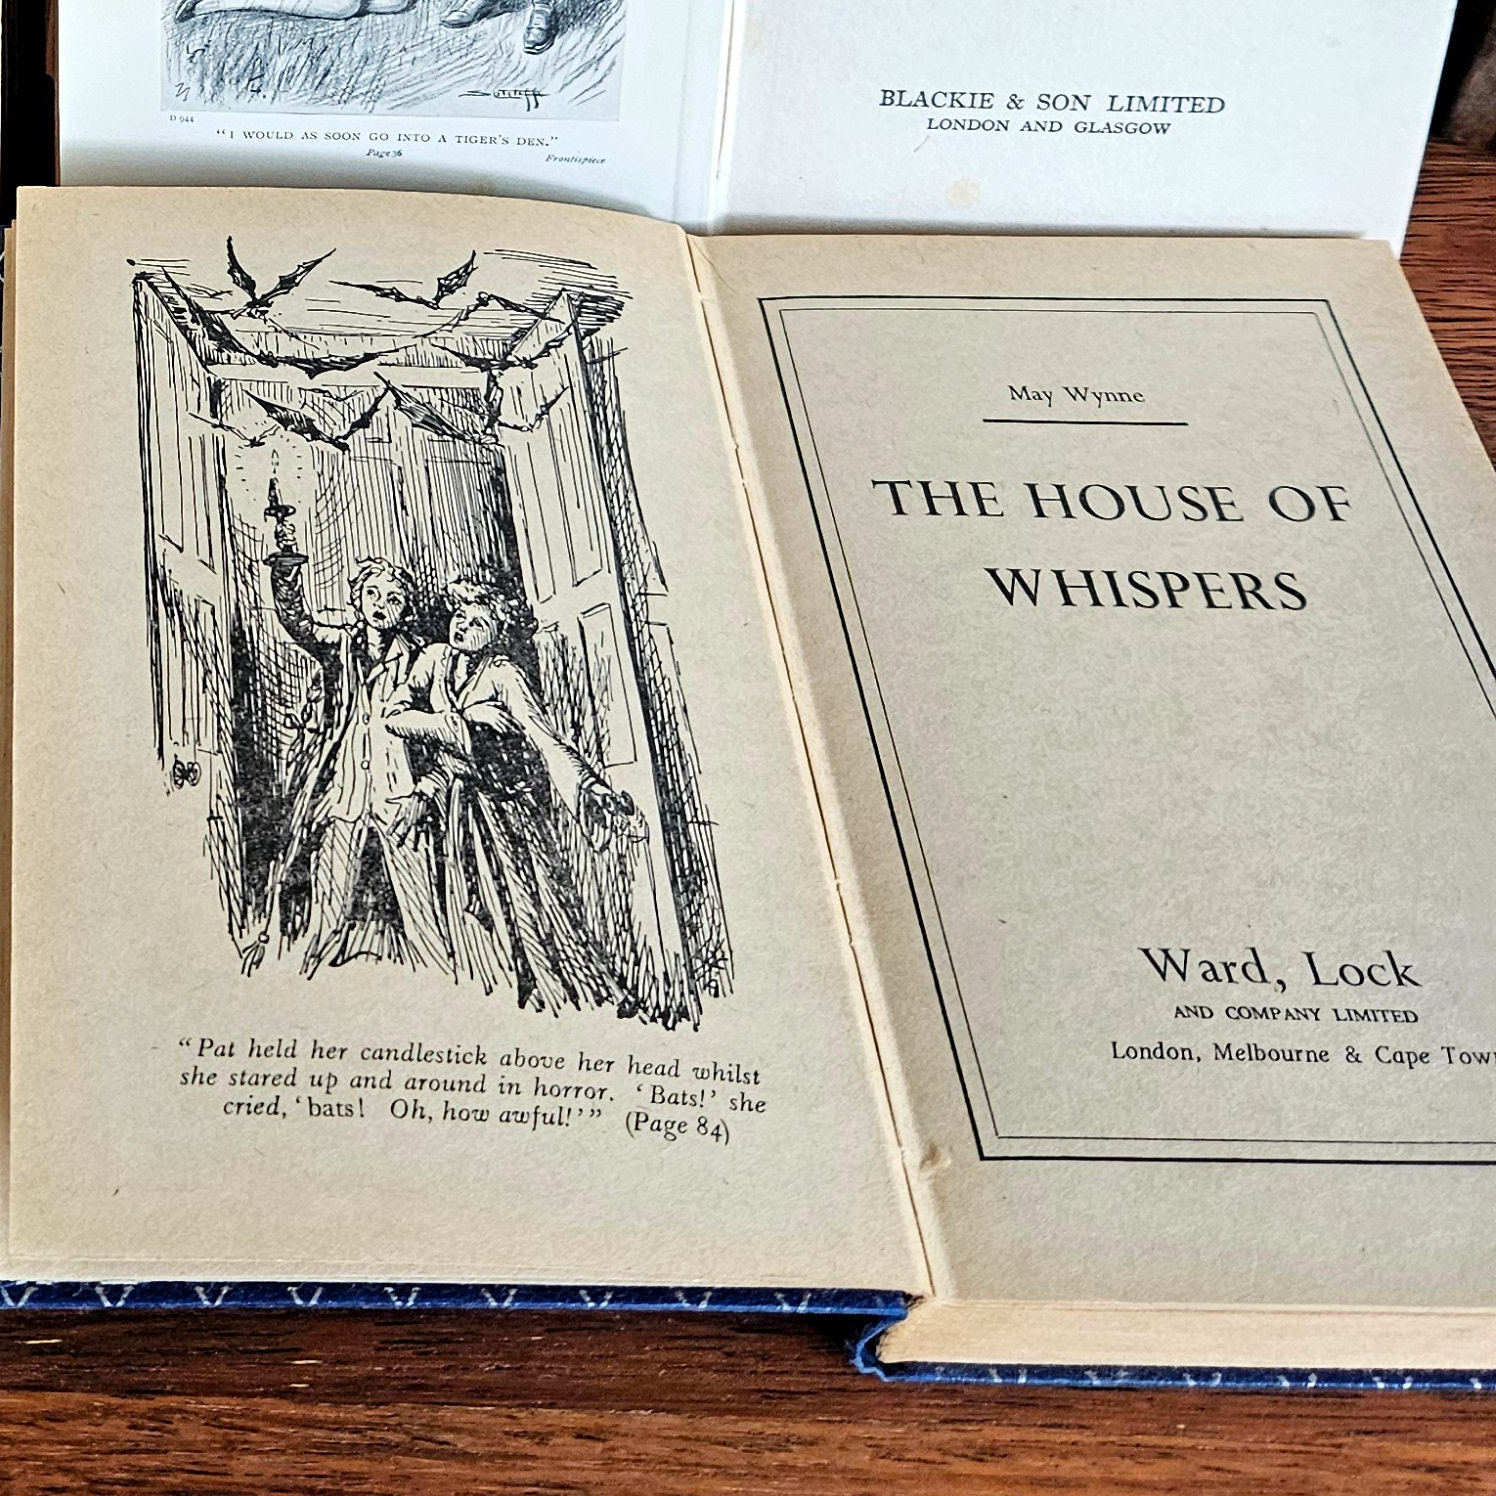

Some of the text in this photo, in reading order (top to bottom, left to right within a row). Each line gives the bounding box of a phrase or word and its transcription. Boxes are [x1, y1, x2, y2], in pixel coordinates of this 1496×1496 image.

[879, 89, 1225, 113] BLACKIE & SON LIMITED
[243, 131, 293, 139] WOULD
[369, 133, 388, 141] GO
[398, 134, 430, 142] INTO
[438, 135, 446, 143] A
[455, 135, 509, 144] TIGER'S
[927, 118, 1171, 134] LONDON AND GLASGOW
[366, 149, 390, 158] Page
[545, 155, 605, 164] Frontispiece
[1008, 386, 1145, 408] May Wynne
[871, 480, 1350, 522] THE HOUSE OF
[984, 568, 1306, 610] WHISPERS
[1138, 947, 1421, 993] Ward, Lock
[1175, 1005, 1418, 1023] AND COMPANY LIMITED
[248, 1038, 297, 1058] held
[311, 1040, 347, 1060] her
[361, 1042, 487, 1065] candlestick
[500, 1048, 564, 1069] above
[579, 1052, 614, 1072] her
[628, 1055, 680, 1078] head
[692, 1062, 760, 1085] whilst
[1112, 1041, 1496, 1069] London, Melbourne & Cape Tow
[180, 1066, 766, 1113] she stared up and around in horror. she
[224, 1095, 729, 1145] cried, Oh, how (Page 84)
